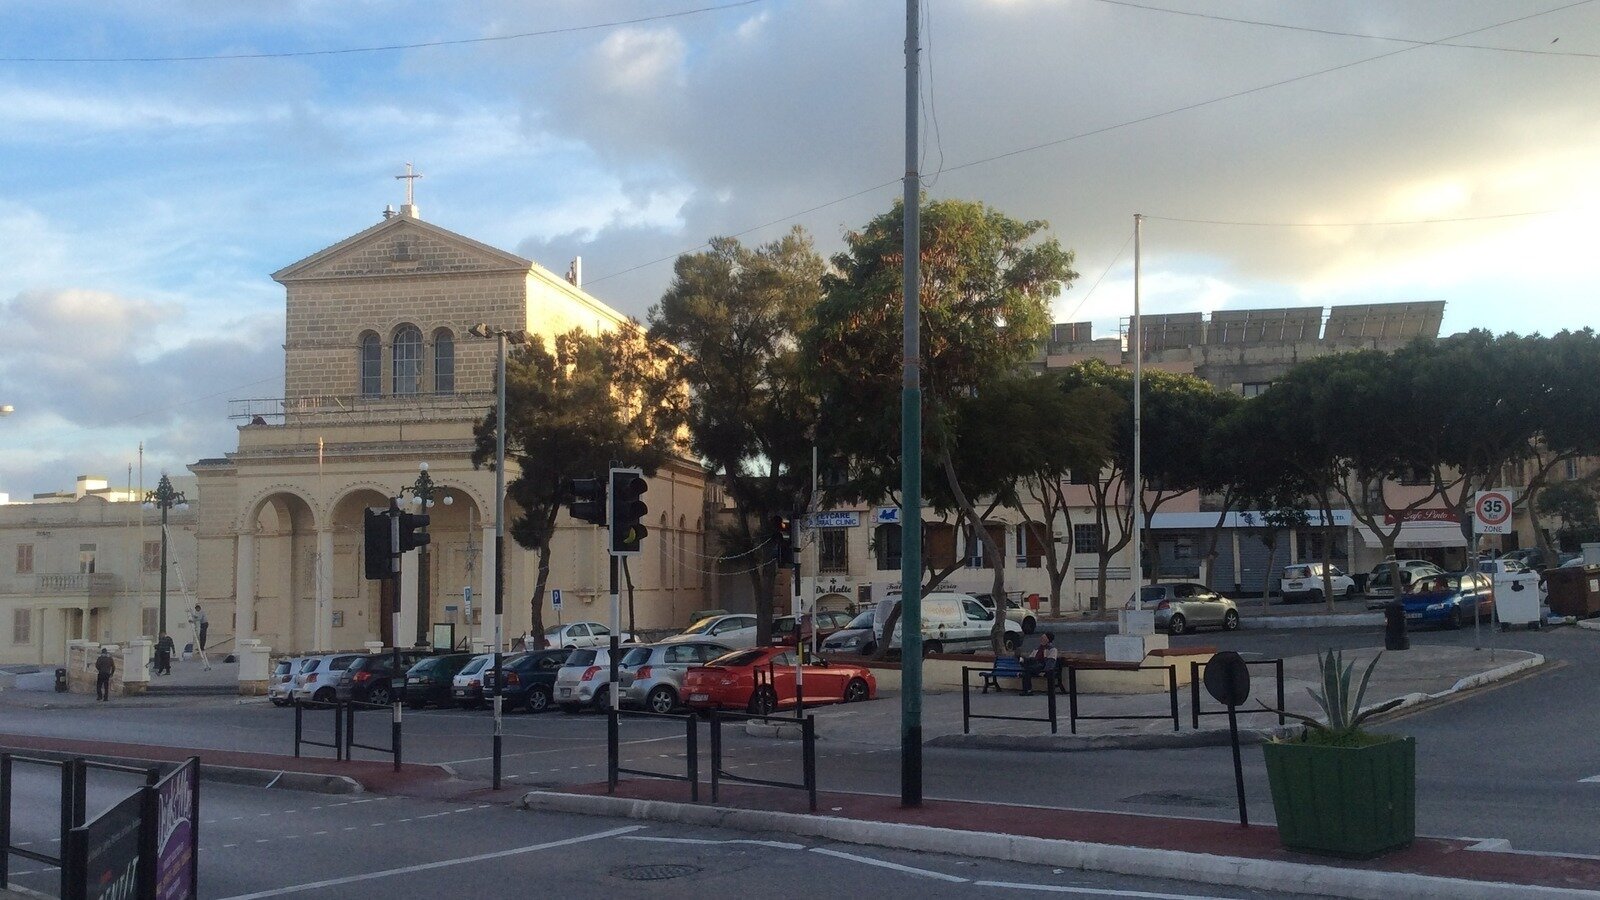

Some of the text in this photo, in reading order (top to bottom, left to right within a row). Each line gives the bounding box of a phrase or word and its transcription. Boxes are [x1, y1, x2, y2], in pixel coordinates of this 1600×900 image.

[1483, 500, 1502, 512] 35
[1424, 510, 1448, 520] Pinto
[1483, 525, 1503, 533] ZONE
[815, 584, 852, 594] De Malte
